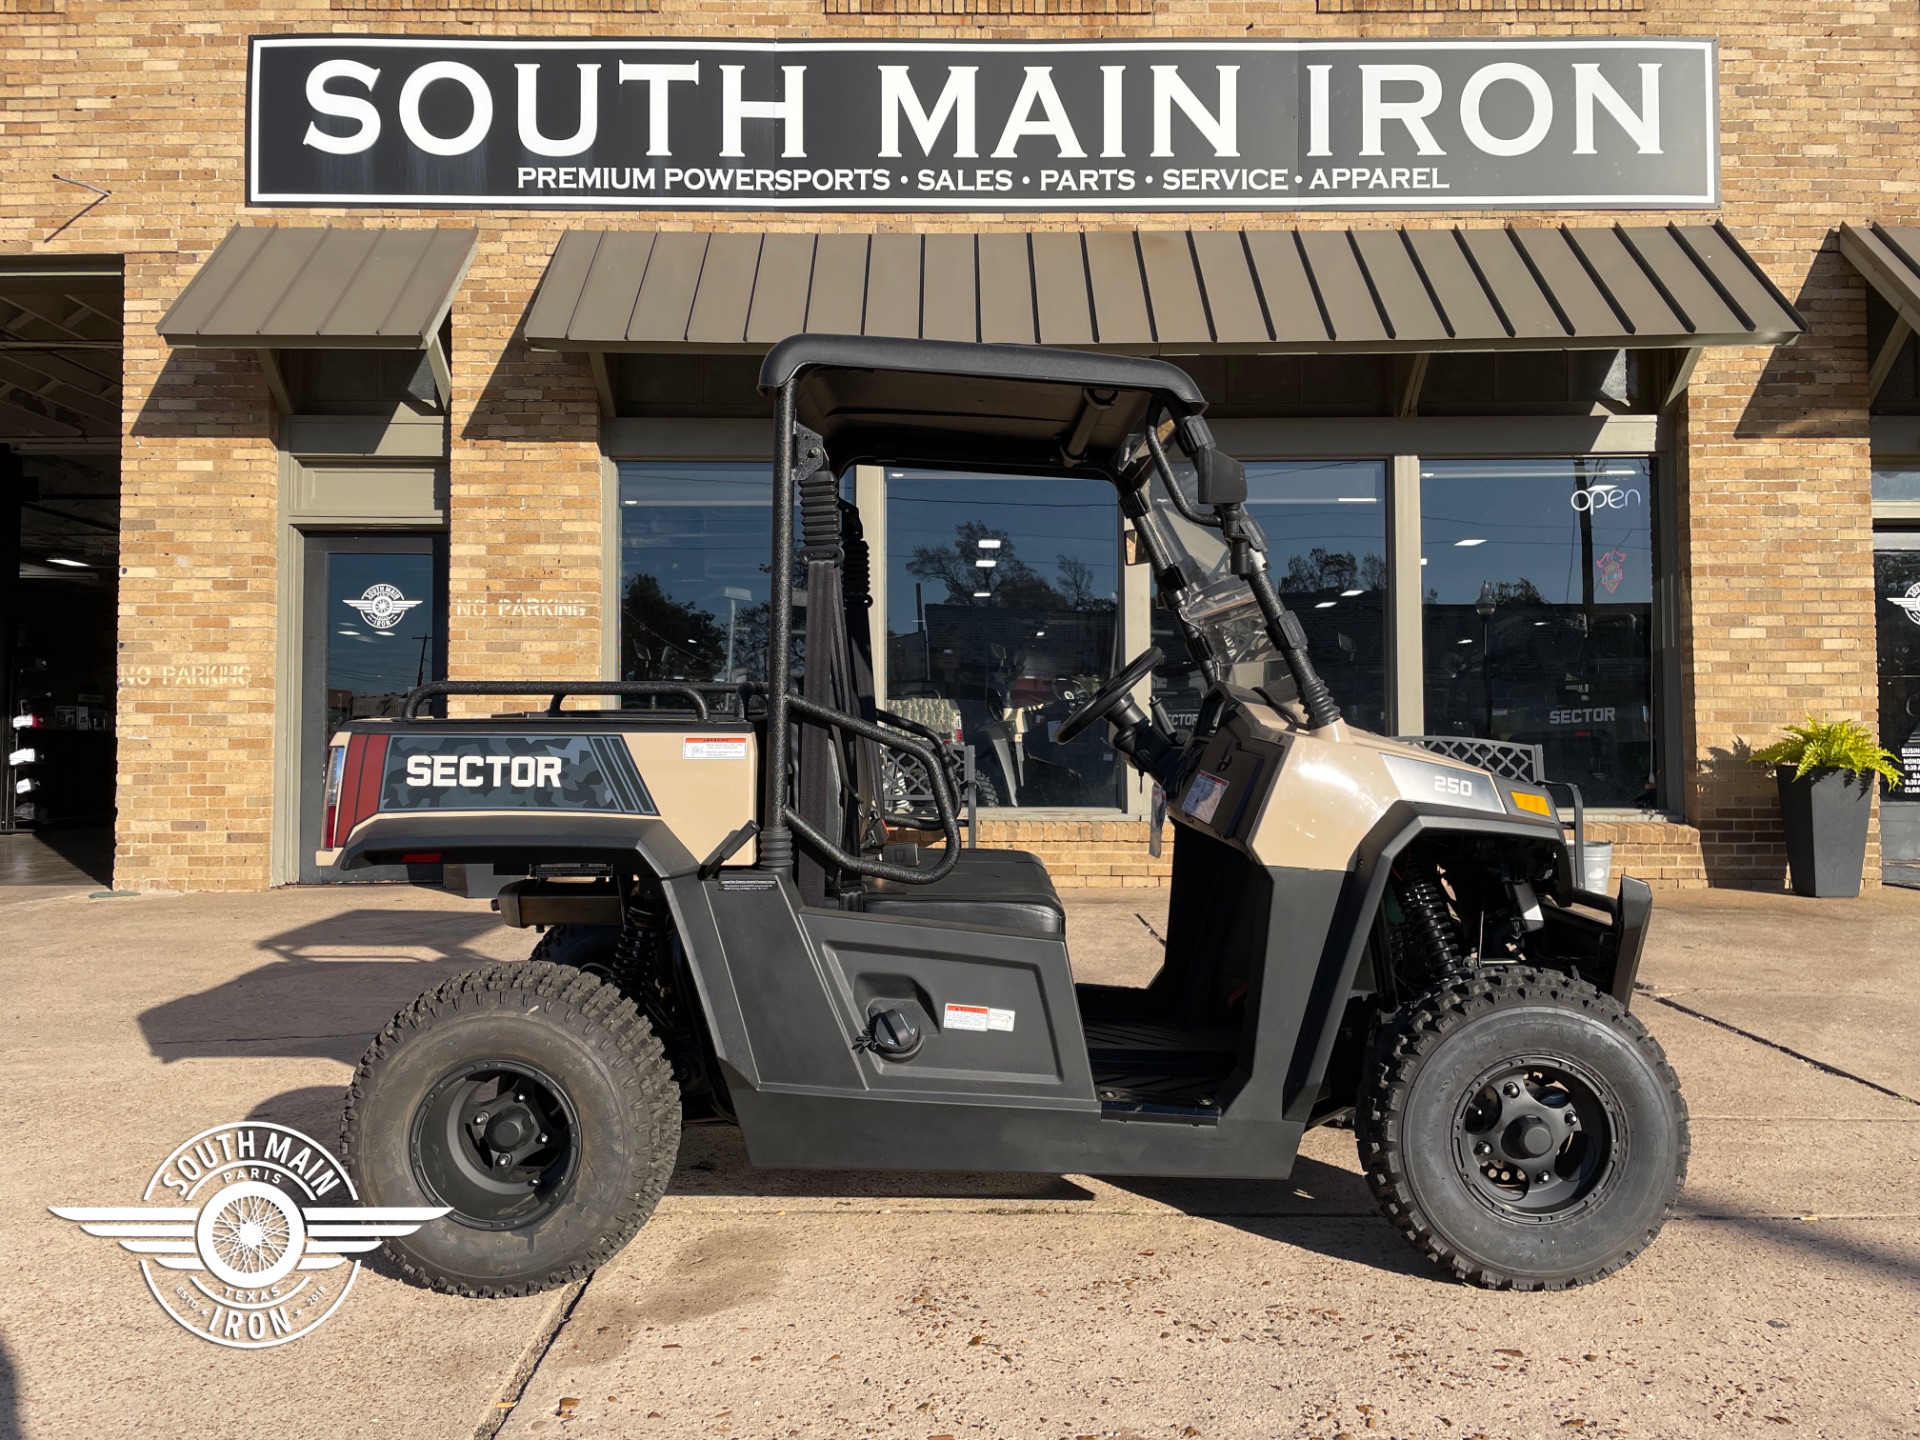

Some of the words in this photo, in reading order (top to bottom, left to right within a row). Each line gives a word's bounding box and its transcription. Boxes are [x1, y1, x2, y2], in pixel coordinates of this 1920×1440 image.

[303, 59, 807, 158] SOUTH
[878, 65, 1240, 158] MAIN
[1306, 62, 1664, 157] IRON
[517, 166, 656, 190] PREMIUM
[664, 168, 891, 191] POWERSPORTS
[917, 169, 1013, 192] SALES
[1040, 169, 1136, 191] PARTS
[1162, 168, 1290, 191] SERVICE
[1308, 167, 1450, 190] APPAREL
[1571, 488, 1641, 515] open
[456, 599, 487, 616] NO
[498, 598, 586, 617] PARKING
[120, 665, 150, 686] NO
[162, 665, 252, 686] PARKING
[1168, 713, 1199, 726] CTOR
[1549, 707, 1616, 725] SECTOR
[406, 755, 562, 788] SECTOR
[1434, 775, 1472, 797] 250
